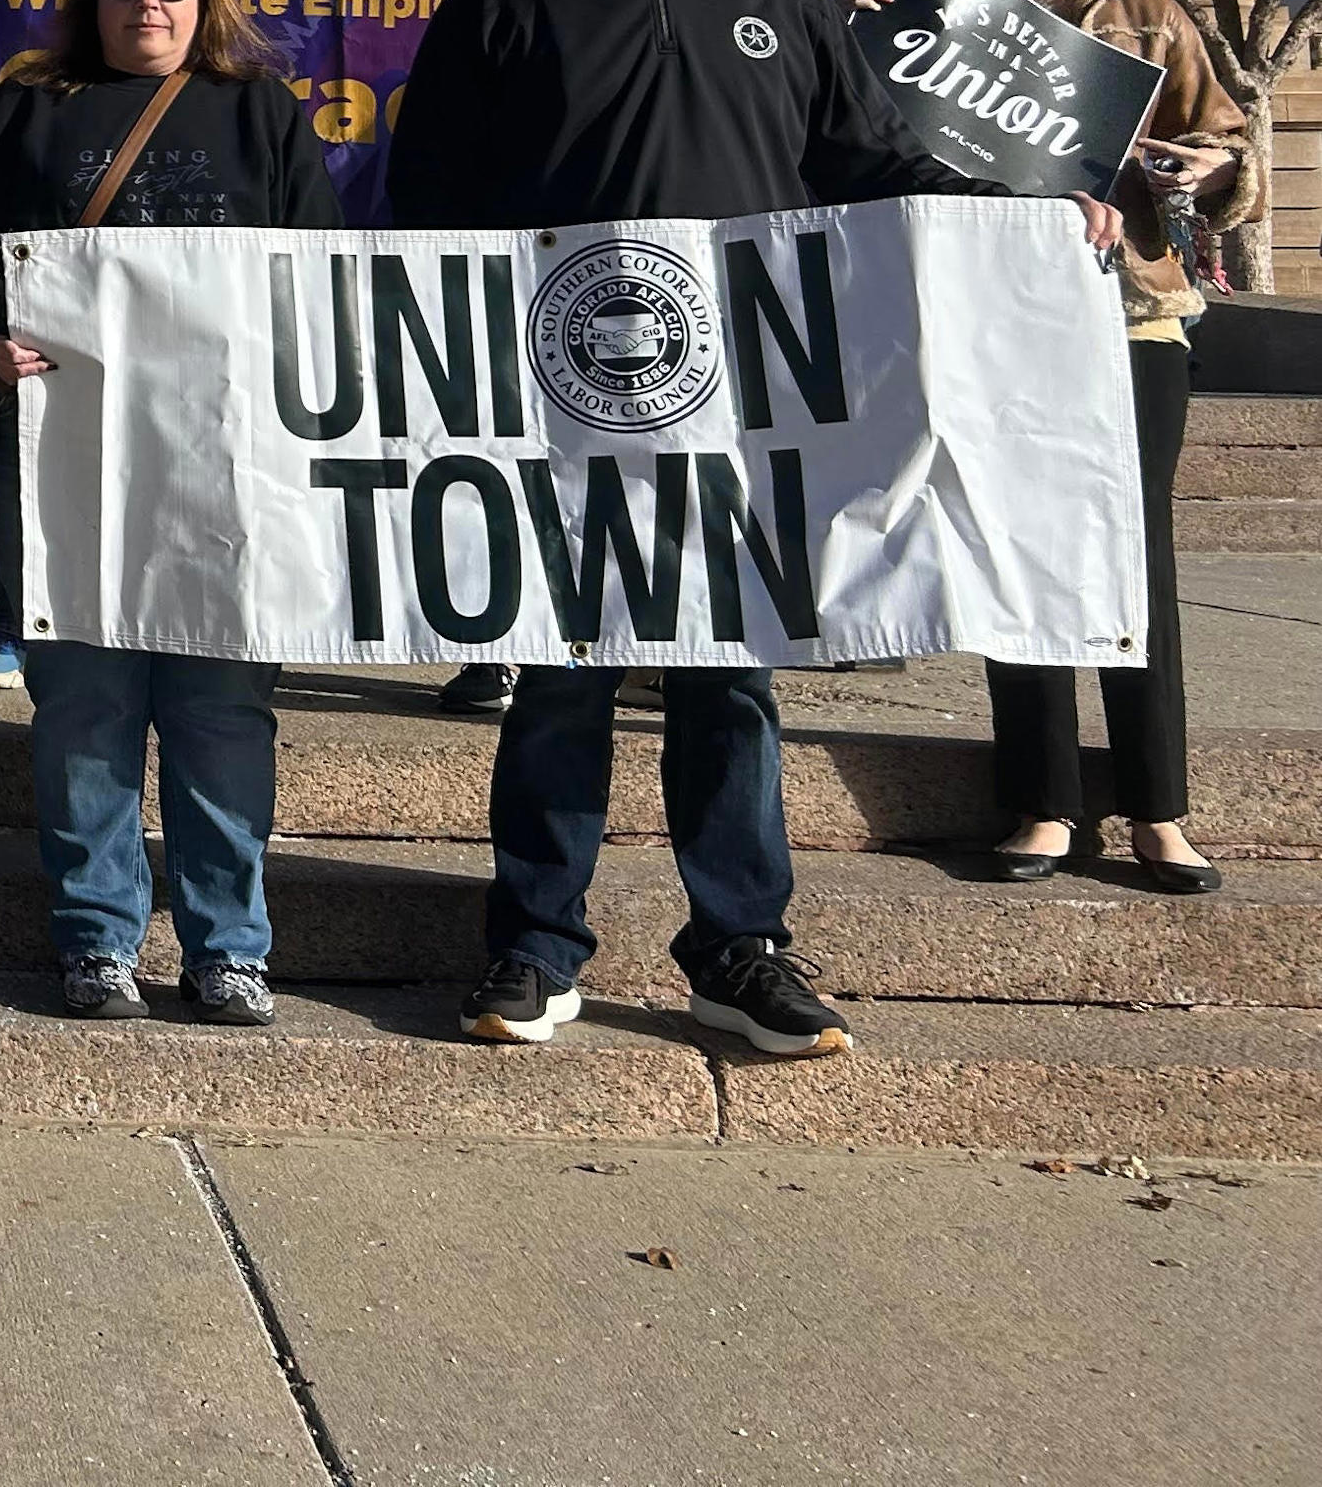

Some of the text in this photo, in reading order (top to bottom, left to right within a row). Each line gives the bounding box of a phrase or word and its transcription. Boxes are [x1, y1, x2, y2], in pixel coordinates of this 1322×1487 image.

[987, 38, 1022, 71] IN A
[1002, 11, 1076, 101] BETTER
[888, 28, 1083, 157] Union
[79, 149, 207, 165] GIING
[938, 125, 996, 163] AFL-CIO
[541, 254, 711, 342] SOUTHERN COLORADO
[568, 282, 683, 346] COLORADO AFL-CIO
[589, 327, 660, 342] AFL CIO
[552, 365, 707, 417] LABOR COUNCIL
[586, 362, 671, 389] Since 1886
[309, 448, 820, 644] TOWN
